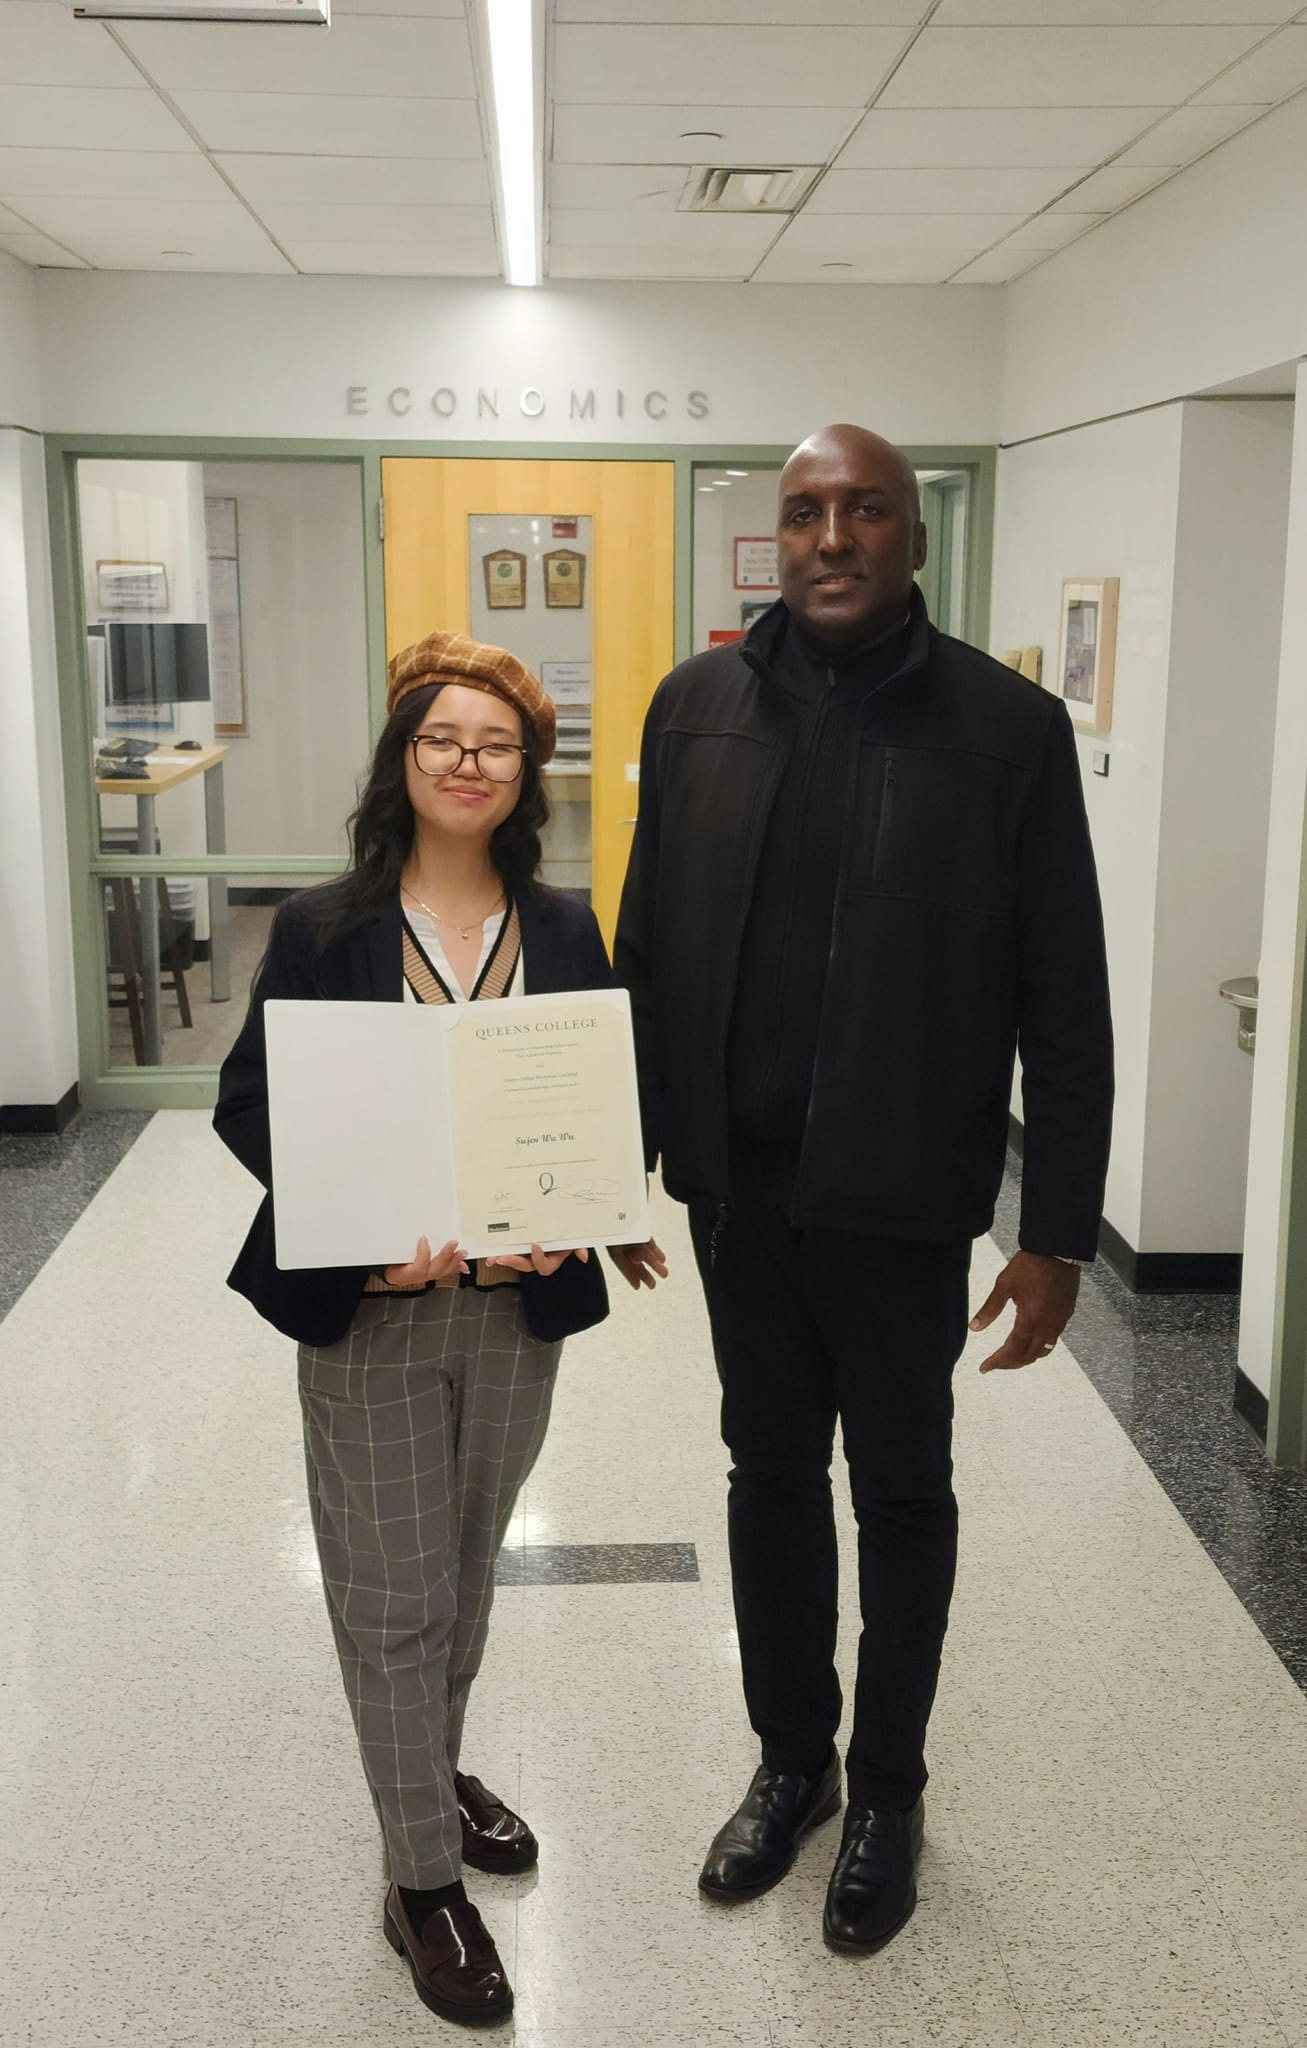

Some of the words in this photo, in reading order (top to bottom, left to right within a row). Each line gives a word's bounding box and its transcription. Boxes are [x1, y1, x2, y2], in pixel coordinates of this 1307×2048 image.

[345, 386, 710, 421] ECONOMICS
[475, 1023, 531, 1040] QUEENS
[535, 1018, 599, 1033] COLLEGE
